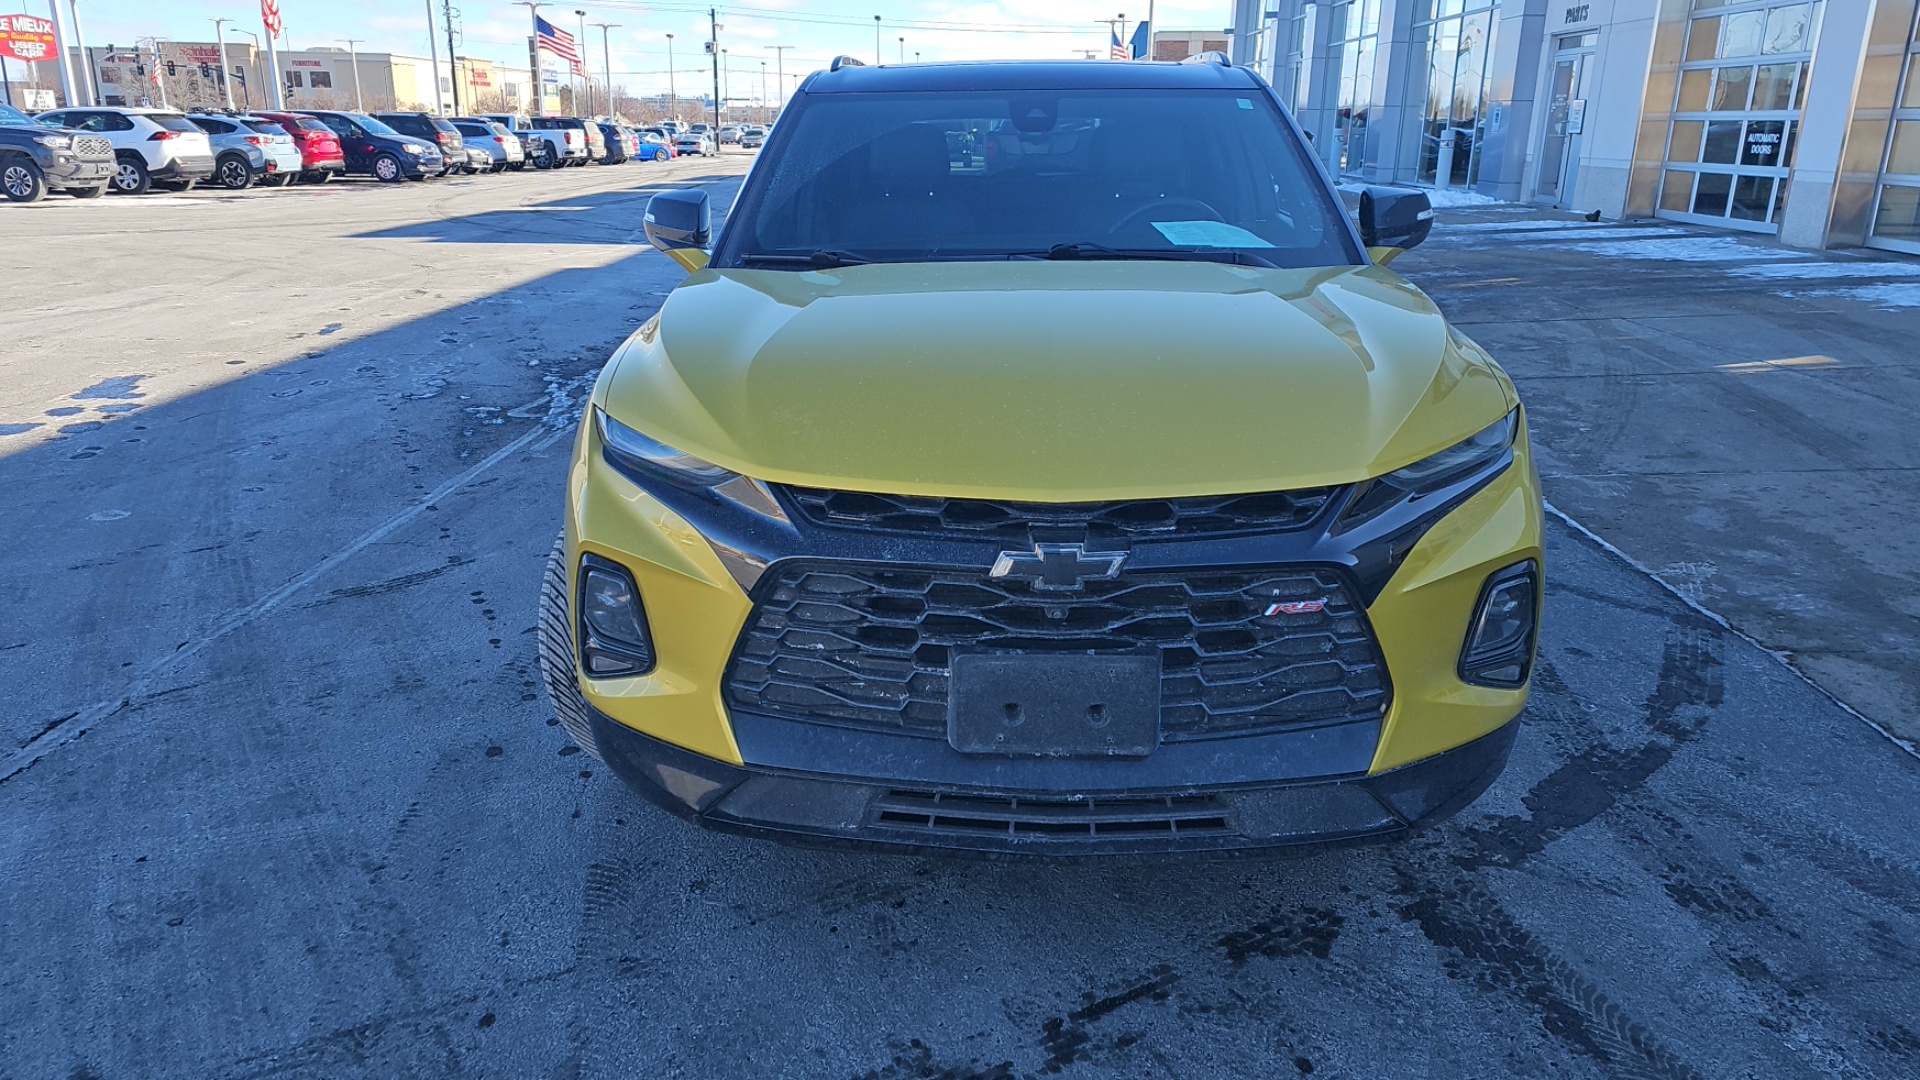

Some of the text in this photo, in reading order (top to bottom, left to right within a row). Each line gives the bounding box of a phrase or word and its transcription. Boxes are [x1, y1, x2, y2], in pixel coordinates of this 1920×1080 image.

[1564, 4, 1590, 24] PARTS
[0, 16, 54, 34] E MIEUX
[11, 32, 39, 42] Quality
[9, 41, 47, 50] USED
[14, 48, 45, 58] CARS
[1747, 133, 1780, 143] AUTOMATIC
[1750, 144, 1772, 154] DOORS
[1264, 601, 1325, 616] RS
